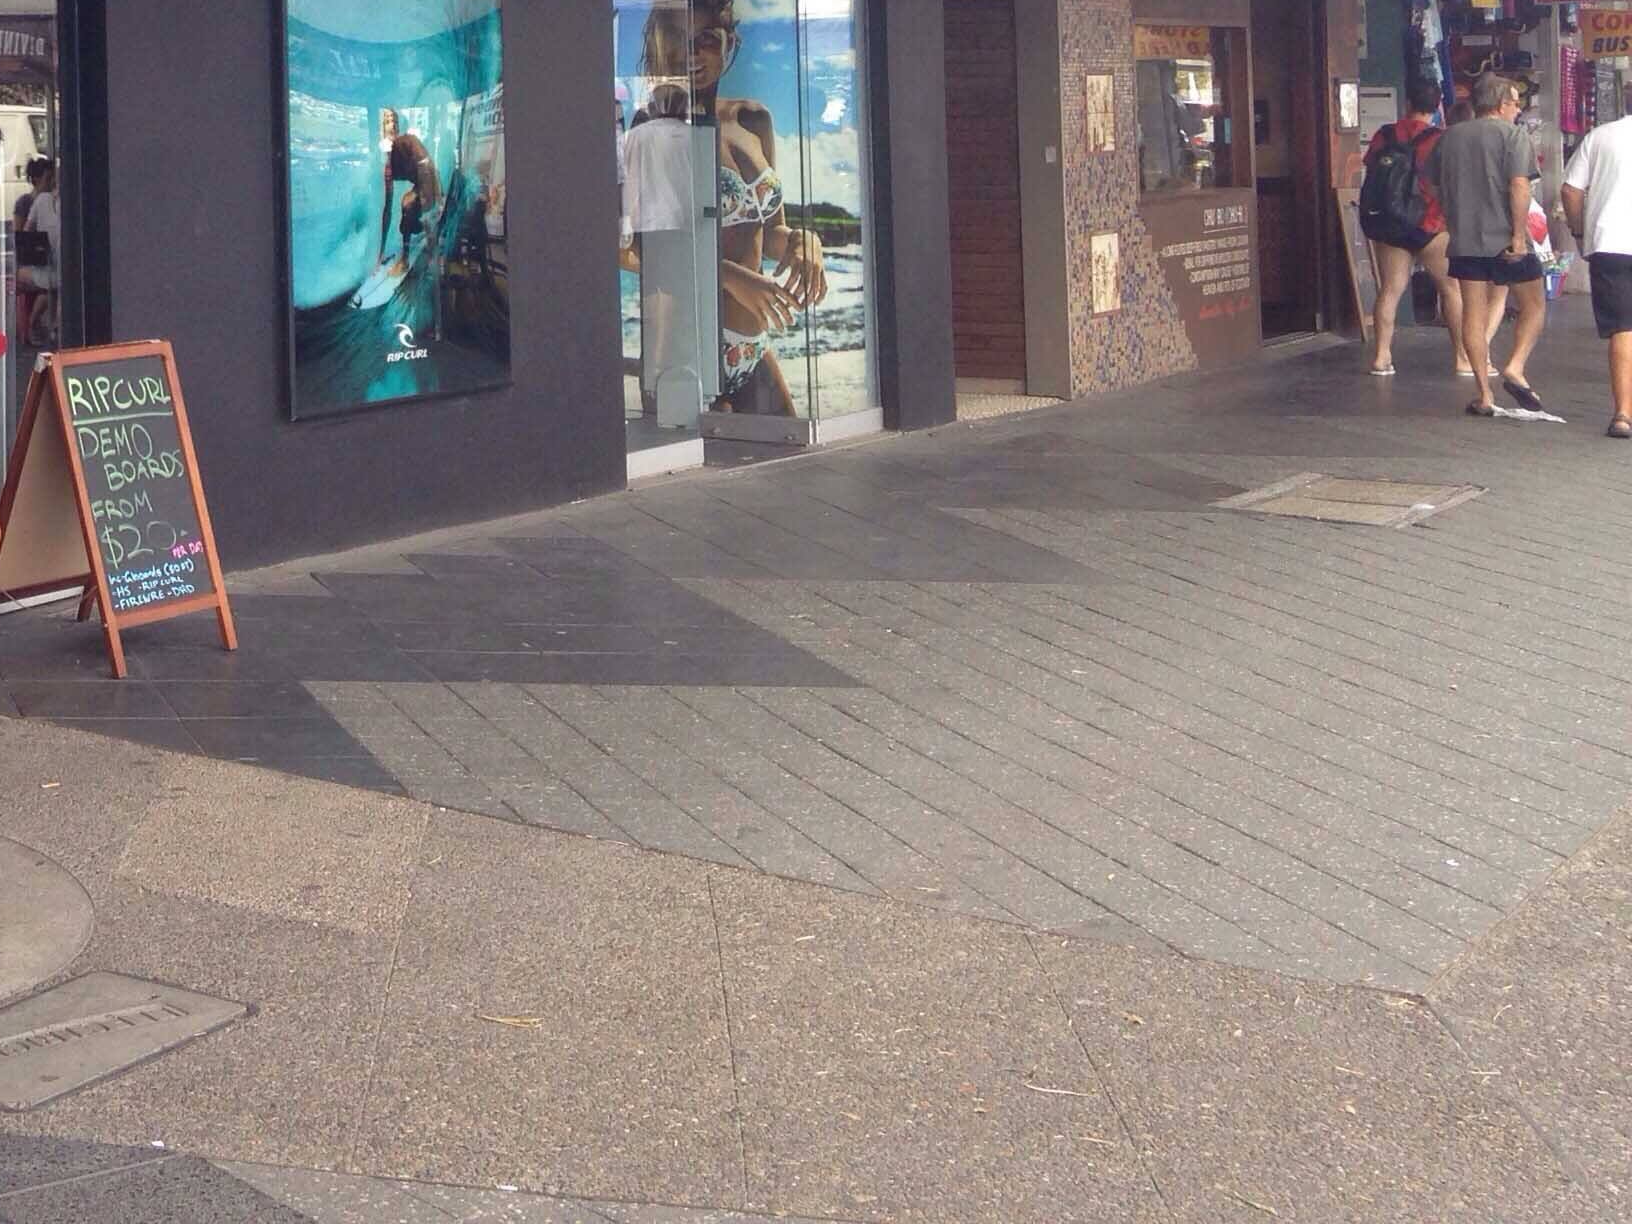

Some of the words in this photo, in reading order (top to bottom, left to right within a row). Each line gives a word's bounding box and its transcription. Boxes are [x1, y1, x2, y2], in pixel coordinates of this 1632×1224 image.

[386, 351, 404, 363] RIP
[404, 348, 428, 361] CURL
[77, 423, 153, 461] DEMO
[103, 448, 185, 492] BOARDS
[90, 489, 153, 523] FROM
